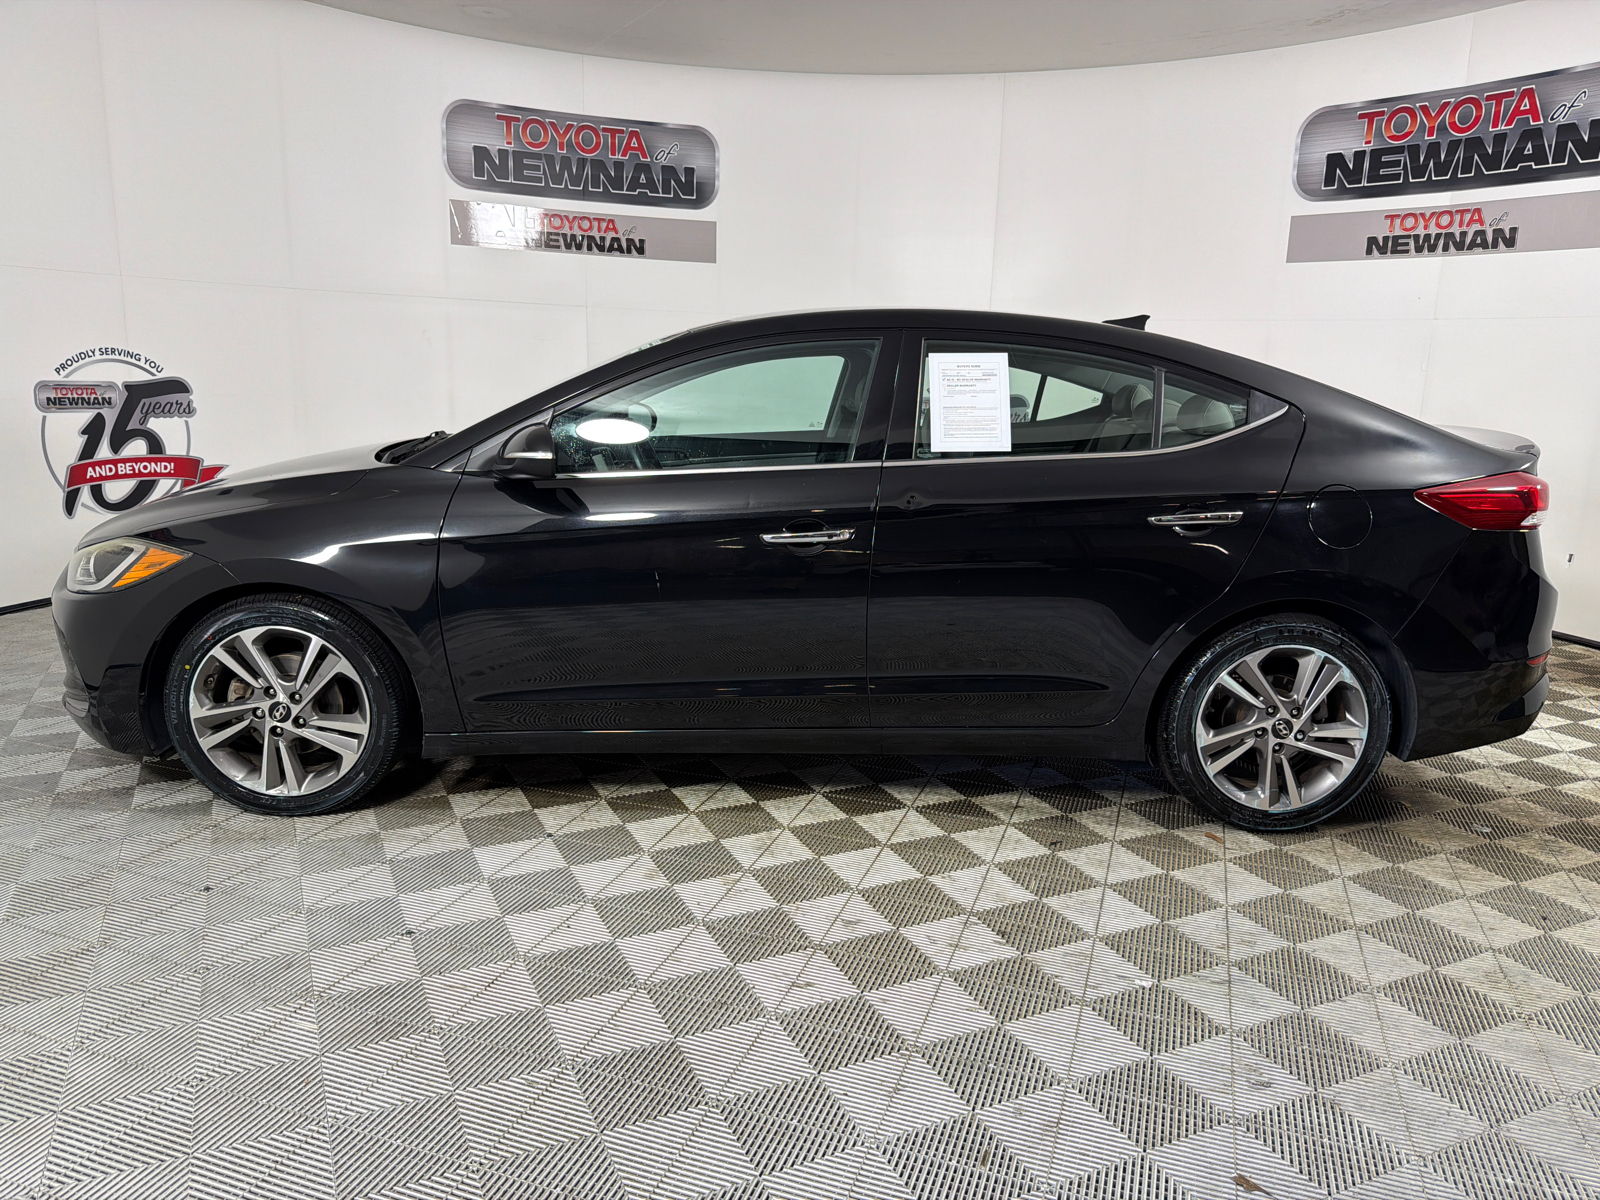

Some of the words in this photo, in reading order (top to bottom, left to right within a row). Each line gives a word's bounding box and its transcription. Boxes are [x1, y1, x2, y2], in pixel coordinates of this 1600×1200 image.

[1357, 85, 1544, 146] TOYOTA
[1548, 89, 1588, 123] of
[495, 113, 649, 161] TOYOTA
[653, 142, 679, 164] of
[1321, 119, 1600, 190] NEWNAN
[472, 144, 697, 199] NEWNAN
[539, 212, 619, 235] TOYOTA
[621, 226, 637, 238] of
[1384, 207, 1486, 233] TOYOTA
[1488, 211, 1509, 228] of
[1365, 226, 1519, 257] NEWNAN
[54, 348, 97, 376] PROUDLY
[98, 347, 142, 362] SERVING
[143, 356, 165, 374] YOU
[45, 396, 113, 407] NEWNAN
[52, 387, 98, 397] TOYOTA
[64, 378, 191, 517] 15
[138, 397, 195, 426] years
[86, 465, 116, 479] AND
[117, 462, 176, 476] BEYOND!
